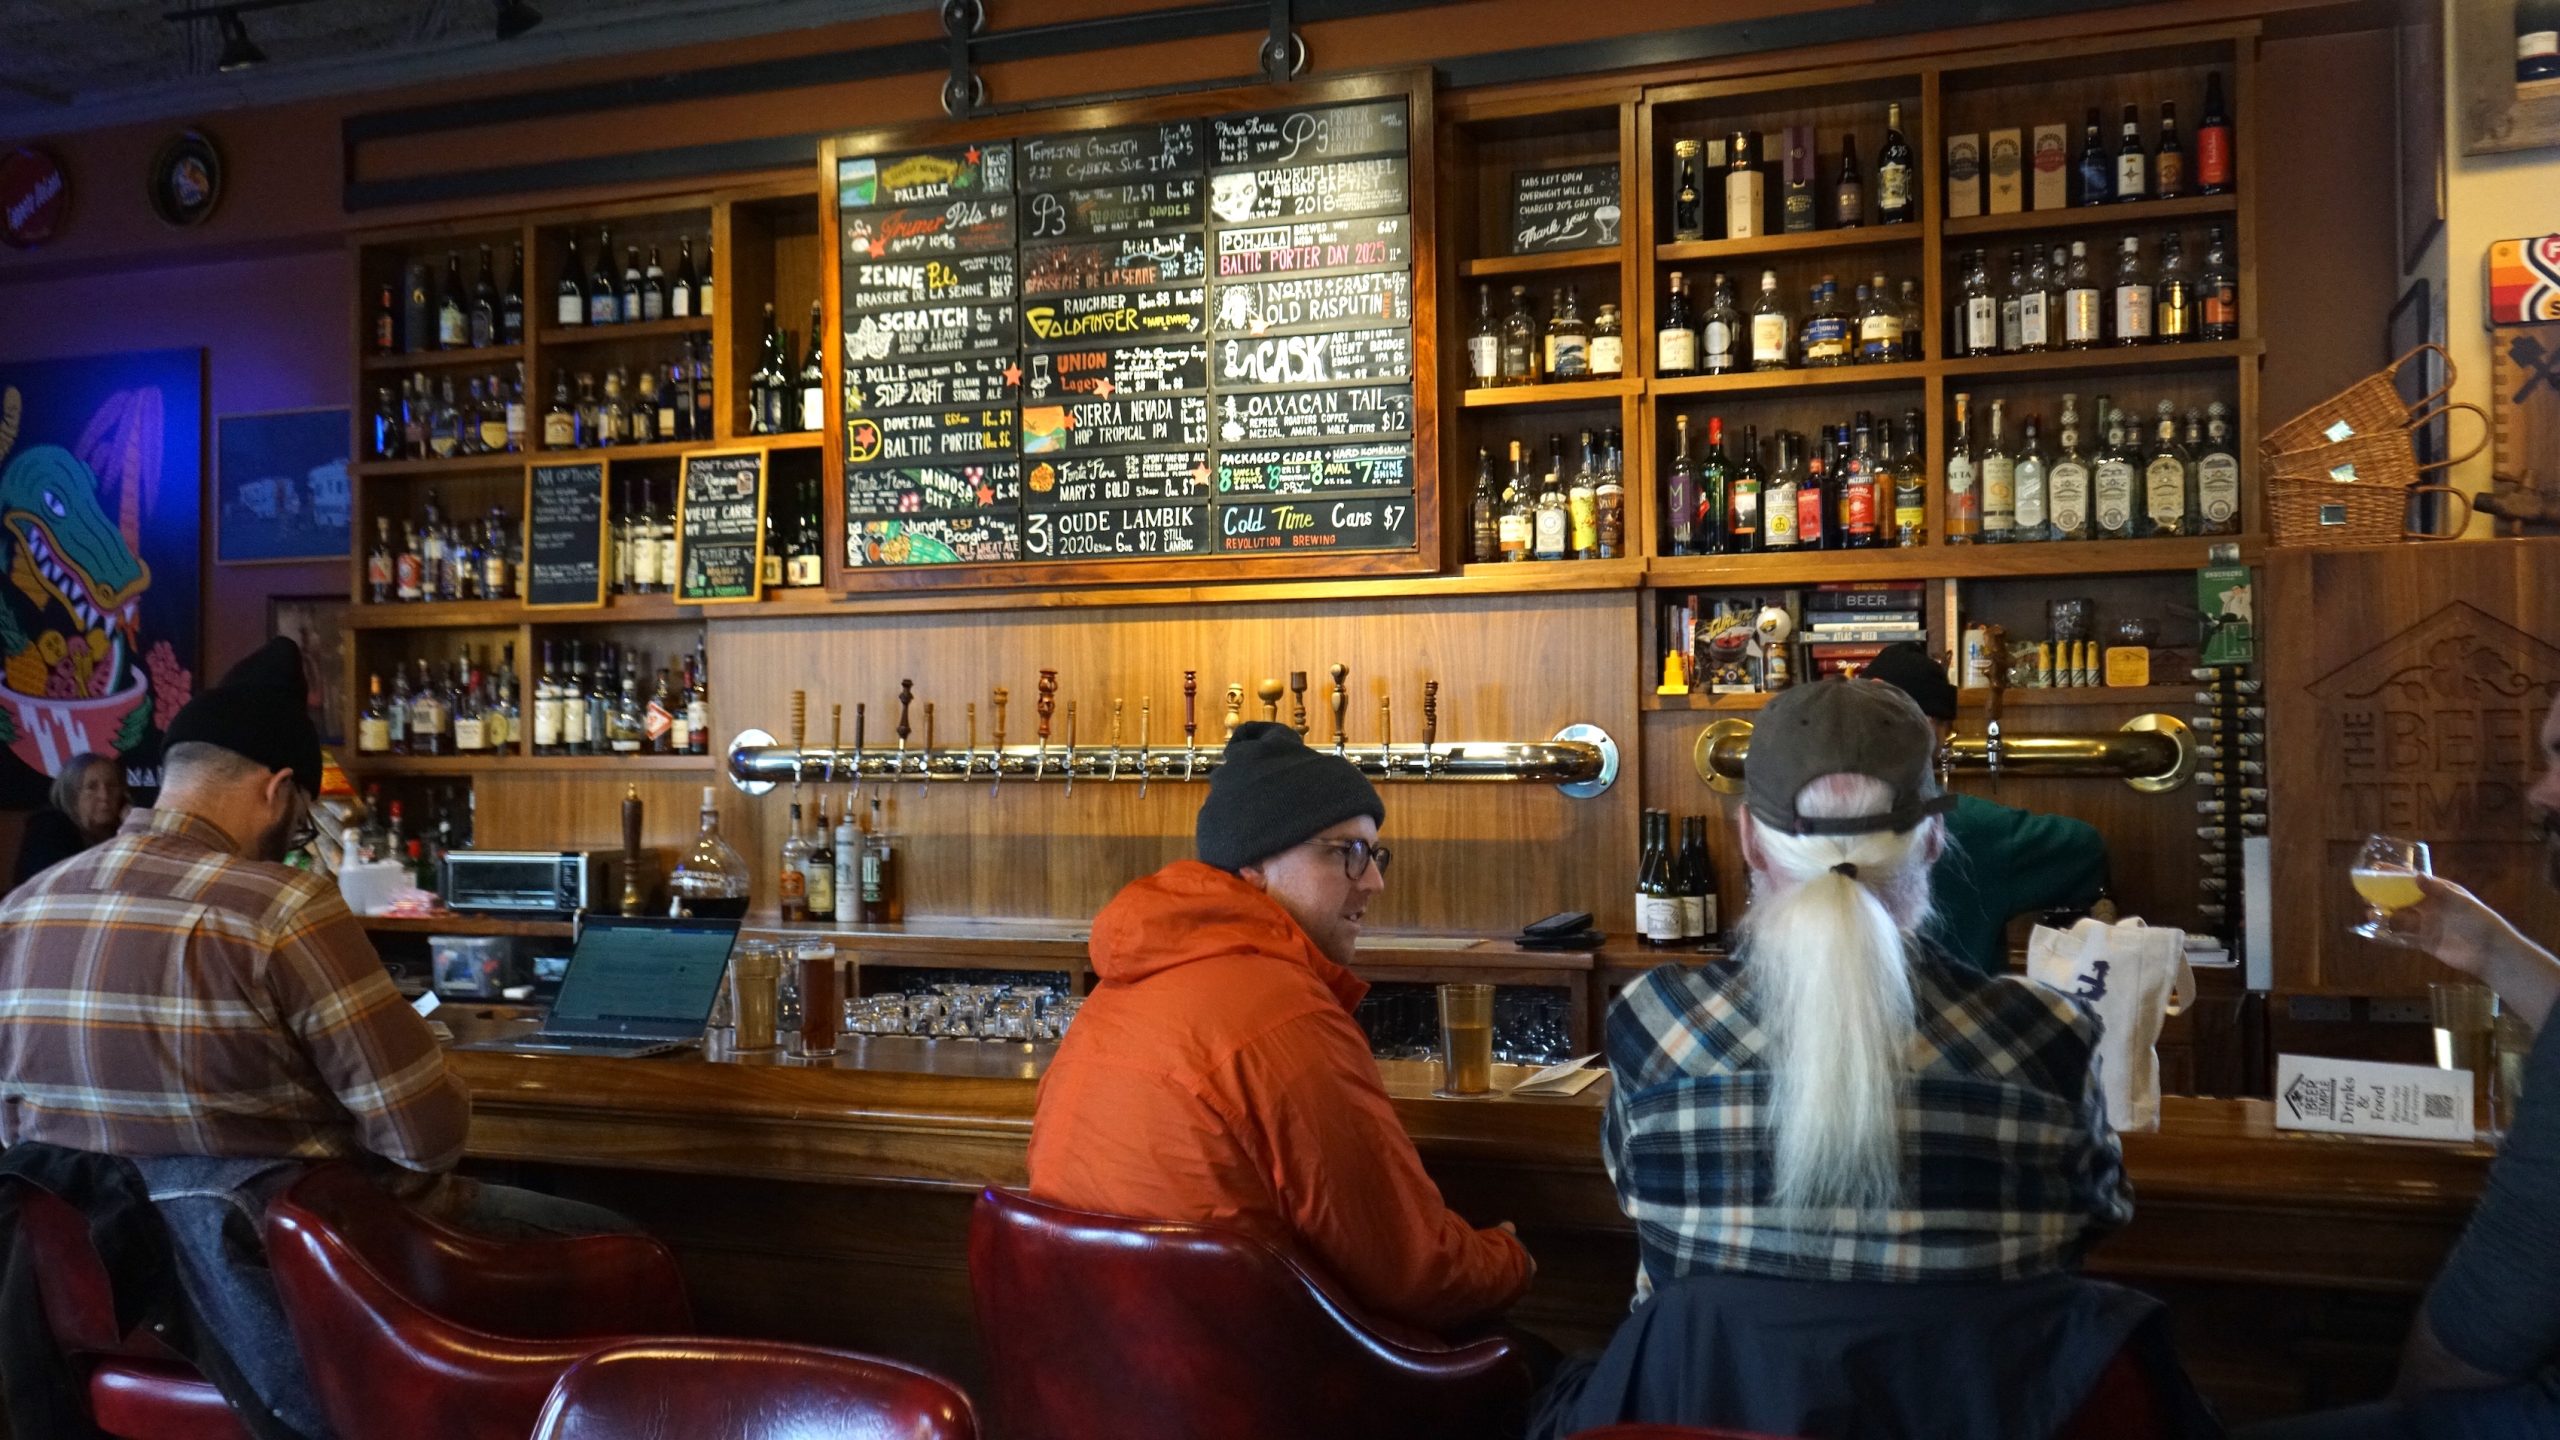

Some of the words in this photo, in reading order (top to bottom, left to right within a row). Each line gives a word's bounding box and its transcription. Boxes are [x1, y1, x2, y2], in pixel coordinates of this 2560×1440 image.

[1215, 120, 1246, 136] Phase
[1246, 116, 1278, 135] Three
[1087, 136, 1138, 156] GOLIATH
[1067, 161, 1113, 181] CYBER
[1118, 157, 1144, 170] SUE
[1148, 155, 1176, 171] IPA
[1257, 163, 1337, 188] QUADRUPLE
[1337, 159, 1396, 178] BARREL
[1292, 181, 1315, 196] BAD
[1317, 176, 1380, 195] BAPTIST
[1521, 176, 1538, 186] TABS
[1540, 173, 1558, 184] LEFT
[1560, 172, 1581, 182] OPEN
[894, 187, 923, 202] PALE
[925, 183, 948, 197] ALE
[1520, 187, 1559, 200] OVERNIGHT
[1561, 186, 1579, 195] WILL
[1581, 183, 1591, 193] BE
[1149, 203, 1190, 216] DOODLE
[1294, 195, 1337, 216] 2018
[1520, 201, 1552, 213] CHARGED
[1555, 200, 1570, 209] 20%
[1572, 194, 1608, 207] GRATUITY
[945, 201, 986, 230] Pils
[1518, 217, 1559, 246] Thank
[1560, 209, 1586, 231] you
[1220, 252, 1262, 276] BALTIC
[1270, 246, 1321, 271] PORTER
[1327, 244, 1349, 266] DAY
[1355, 241, 1386, 264] 2025
[860, 265, 925, 289] ZENNE
[927, 261, 958, 289] Pils
[1085, 273, 1099, 288] DE
[1121, 266, 1156, 284] SENNE
[856, 289, 908, 308] BRASSERIE
[912, 288, 925, 301] DE
[929, 286, 944, 300] LA
[948, 282, 983, 298] SENNE
[1267, 280, 1321, 302] NORTH
[1336, 273, 1385, 295] COAST
[1063, 294, 1127, 315] RAUCHBIER
[1266, 298, 1301, 325] OLD
[1310, 293, 1383, 320] RASPUTIN
[878, 307, 968, 331] SCRATCH
[1026, 307, 1139, 339] GOLDFINGER
[930, 327, 967, 342] LEAVES
[1330, 341, 1363, 357] TRENT
[1369, 338, 1405, 352] BRIDGE
[1057, 352, 1107, 373] UNION
[1256, 335, 1329, 383] CASK
[1331, 355, 1365, 367] ENGLISH
[1375, 352, 1389, 363] IPA
[846, 369, 861, 385] DE
[986, 387, 1002, 400] ALE
[1248, 392, 1338, 417] OAXACAN
[1348, 389, 1387, 411] TAIL
[883, 415, 935, 431] DOVETAIL
[1073, 401, 1122, 428] SIERRA
[1130, 398, 1173, 422] NEVADA
[1250, 416, 1278, 428] REPRISE
[1284, 415, 1317, 426] ROASTERS
[1381, 411, 1405, 432] $12
[1074, 428, 1093, 445] HOP
[1099, 424, 1145, 443] TROPICAL
[1152, 422, 1167, 438] IPA
[883, 435, 932, 459] BALTIC
[941, 432, 982, 453] PORTER
[1219, 452, 1280, 465] PACKAGED
[1282, 450, 1321, 462] CIDER
[1333, 448, 1359, 460] HARD
[1360, 445, 1406, 457] KOMBUCHA
[1233, 466, 1261, 477] UNCLE
[1281, 466, 1301, 474] ERIS
[1324, 463, 1351, 476] AVAL
[1373, 468, 1403, 479] SHINE
[1374, 460, 1402, 471] JUNE
[920, 469, 973, 502] MIMOSA
[1060, 482, 1096, 502] MARY'S
[1105, 481, 1129, 499] GOLD
[1283, 482, 1304, 491] DRY
[925, 487, 952, 509] CITY
[685, 506, 717, 522] VIEUX
[721, 503, 754, 519] CARRE
[1059, 510, 1110, 534] OUDE
[1122, 507, 1194, 529] LAMBIK
[1223, 506, 1266, 535] Cold
[1271, 505, 1315, 530] Time
[1331, 502, 1372, 528] Cans
[1383, 505, 1405, 531] $7
[905, 518, 947, 539] Jungle
[944, 528, 989, 546] Boogie
[1163, 528, 1183, 540] STILL
[1003, 541, 1019, 552] ALE
[1060, 534, 1093, 554] 2020
[1115, 531, 1132, 552] 6oz
[1139, 530, 1156, 551] $12
[1163, 538, 1193, 552] LAMBIC
[1226, 536, 1281, 549] REVOLUTION
[1292, 534, 1336, 546] BREWING
[1846, 595, 1888, 606] BEER
[1833, 631, 1852, 641] ATLAS
[1861, 631, 1878, 641] BEER
[2343, 711, 2376, 775] THE
[2306, 1080, 2317, 1110] BEER
[2319, 1080, 2330, 1116] TEMPLE
[2340, 1077, 2355, 1124] Drinks
[2357, 1096, 2370, 1109] &
[2371, 1085, 2386, 1121] Food
